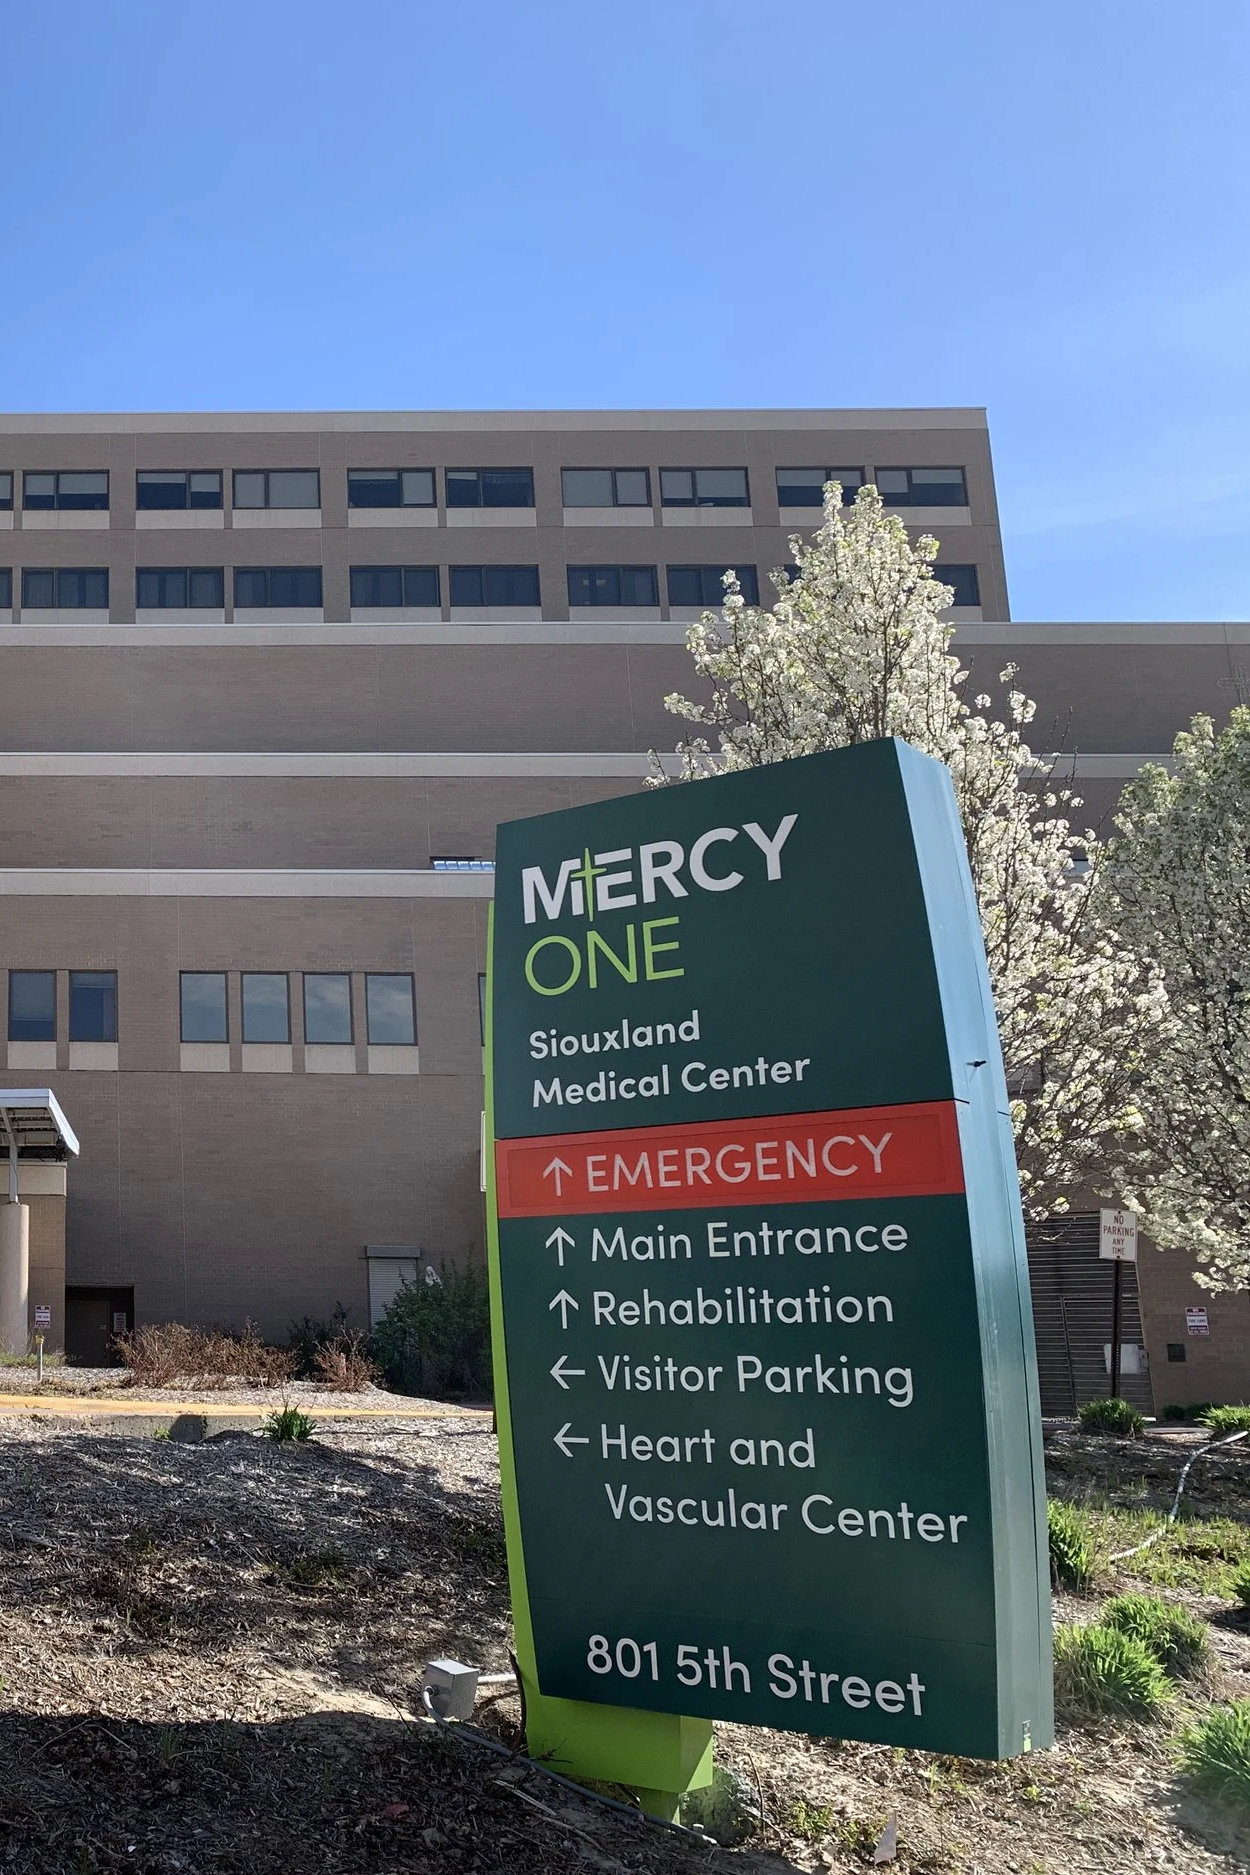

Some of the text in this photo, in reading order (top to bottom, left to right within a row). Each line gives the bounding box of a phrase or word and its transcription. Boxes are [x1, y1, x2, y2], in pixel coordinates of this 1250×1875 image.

[521, 814, 798, 923] MERCY
[525, 916, 684, 996] ONE
[530, 1010, 699, 1059] Siouxland
[533, 1057, 810, 1107] Medical Center
[587, 1133, 891, 1191] EMERGENCY
[592, 1222, 907, 1261] Main Entrance
[1103, 1225, 1135, 1237] PARKING
[1112, 1238, 1125, 1246] ANY
[1114, 1215, 1124, 1225] NO
[1112, 1247, 1125, 1255] TIME
[594, 1286, 892, 1325] Rehabilitation
[598, 1354, 913, 1407] Visitor Parking
[602, 1424, 815, 1467] Heart and
[605, 1484, 967, 1542] Vascular Center
[588, 1635, 925, 1715] 801 5th Street
